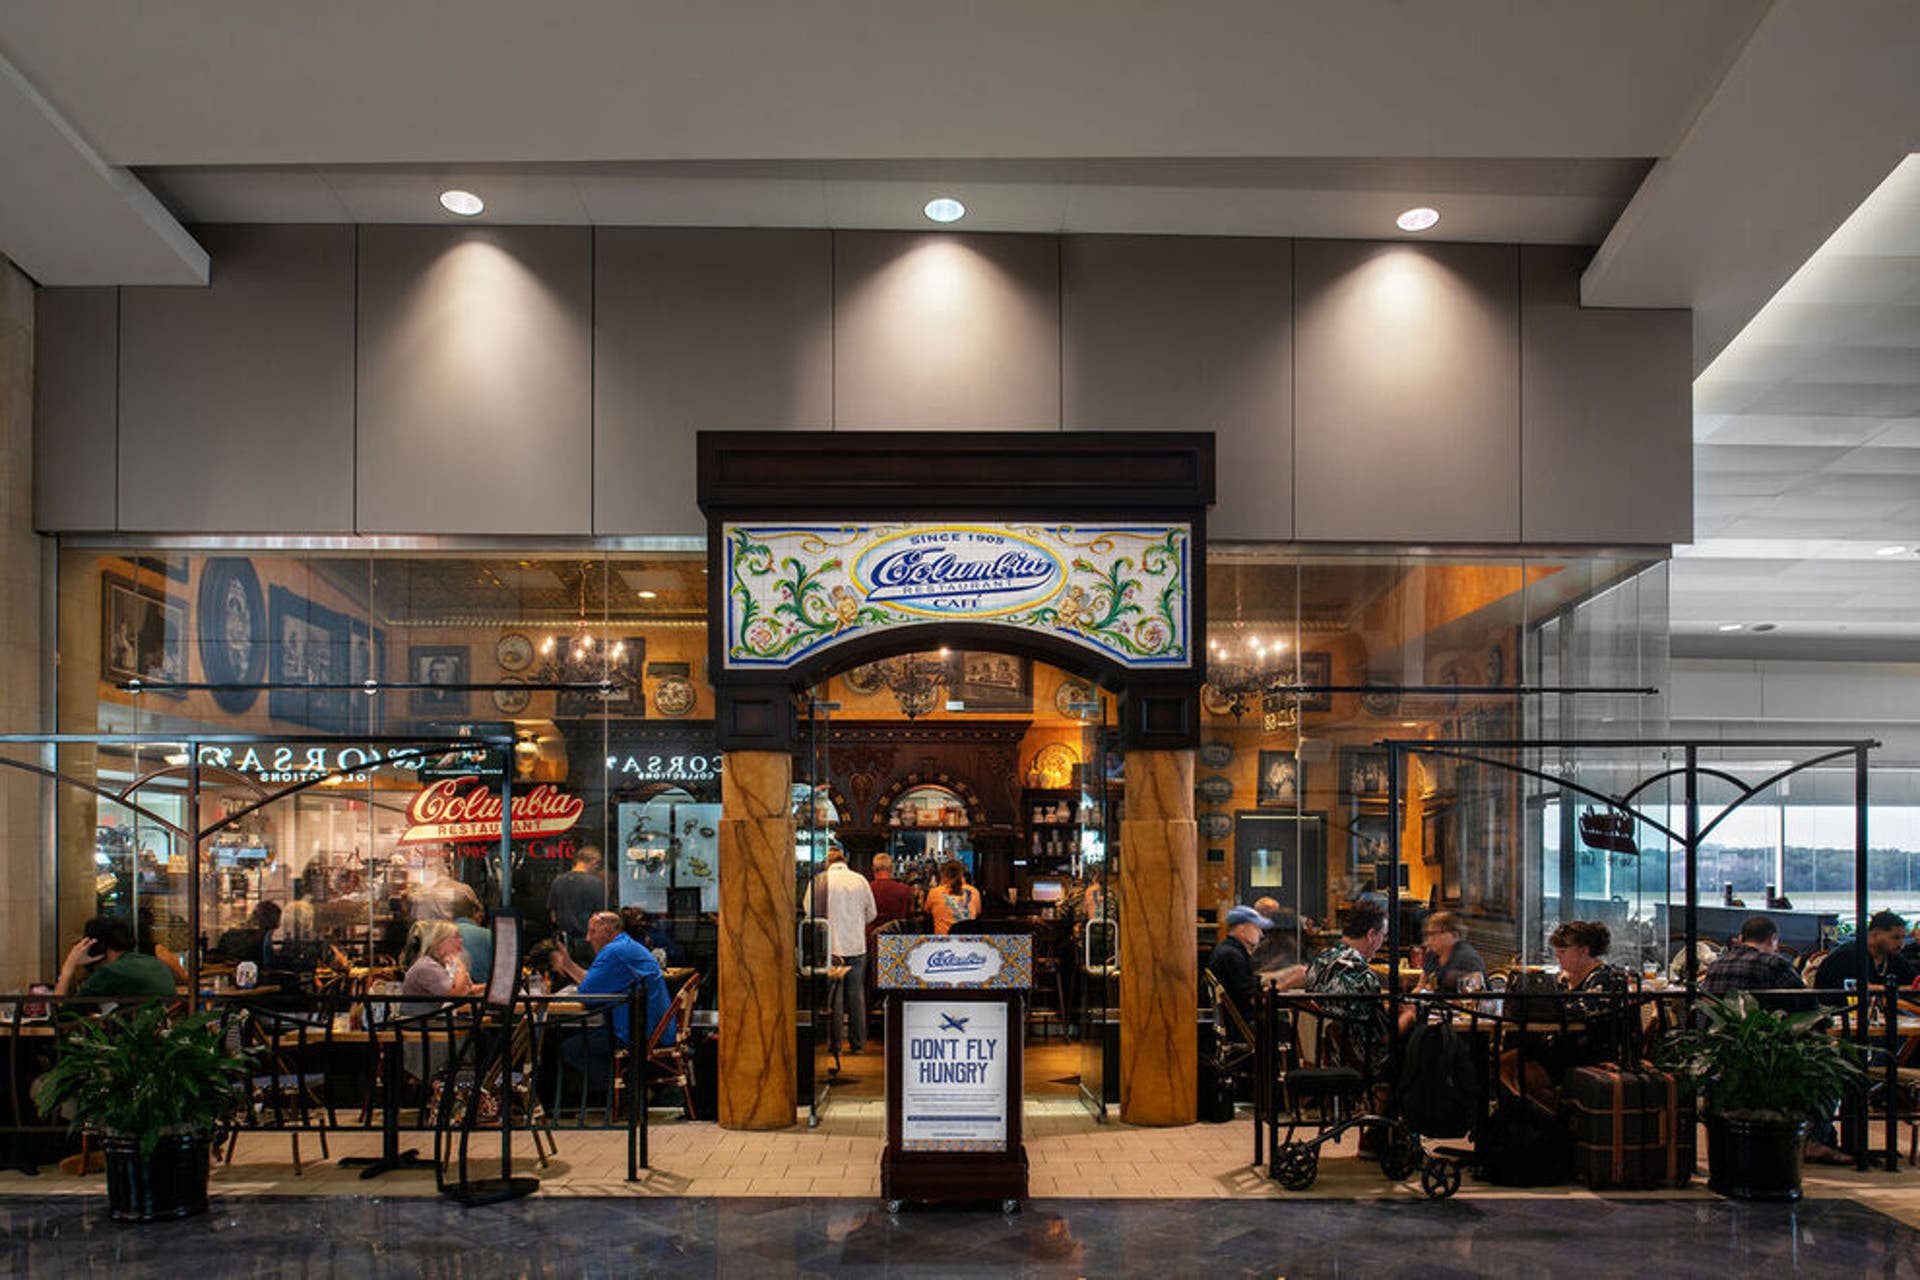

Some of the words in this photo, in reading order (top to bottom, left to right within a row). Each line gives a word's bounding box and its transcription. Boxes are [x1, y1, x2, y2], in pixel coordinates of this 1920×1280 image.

[909, 533, 961, 545] SINCE
[969, 533, 1005, 545] 1905
[870, 547, 1056, 588] Columbia
[903, 580, 1013, 595] RESTAURANT
[438, 820, 542, 836] RESTAUANT
[528, 840, 576, 859] Café
[911, 1039, 959, 1060] DON'T
[967, 1039, 998, 1060] FLY
[919, 1062, 988, 1084] HUNGRY
